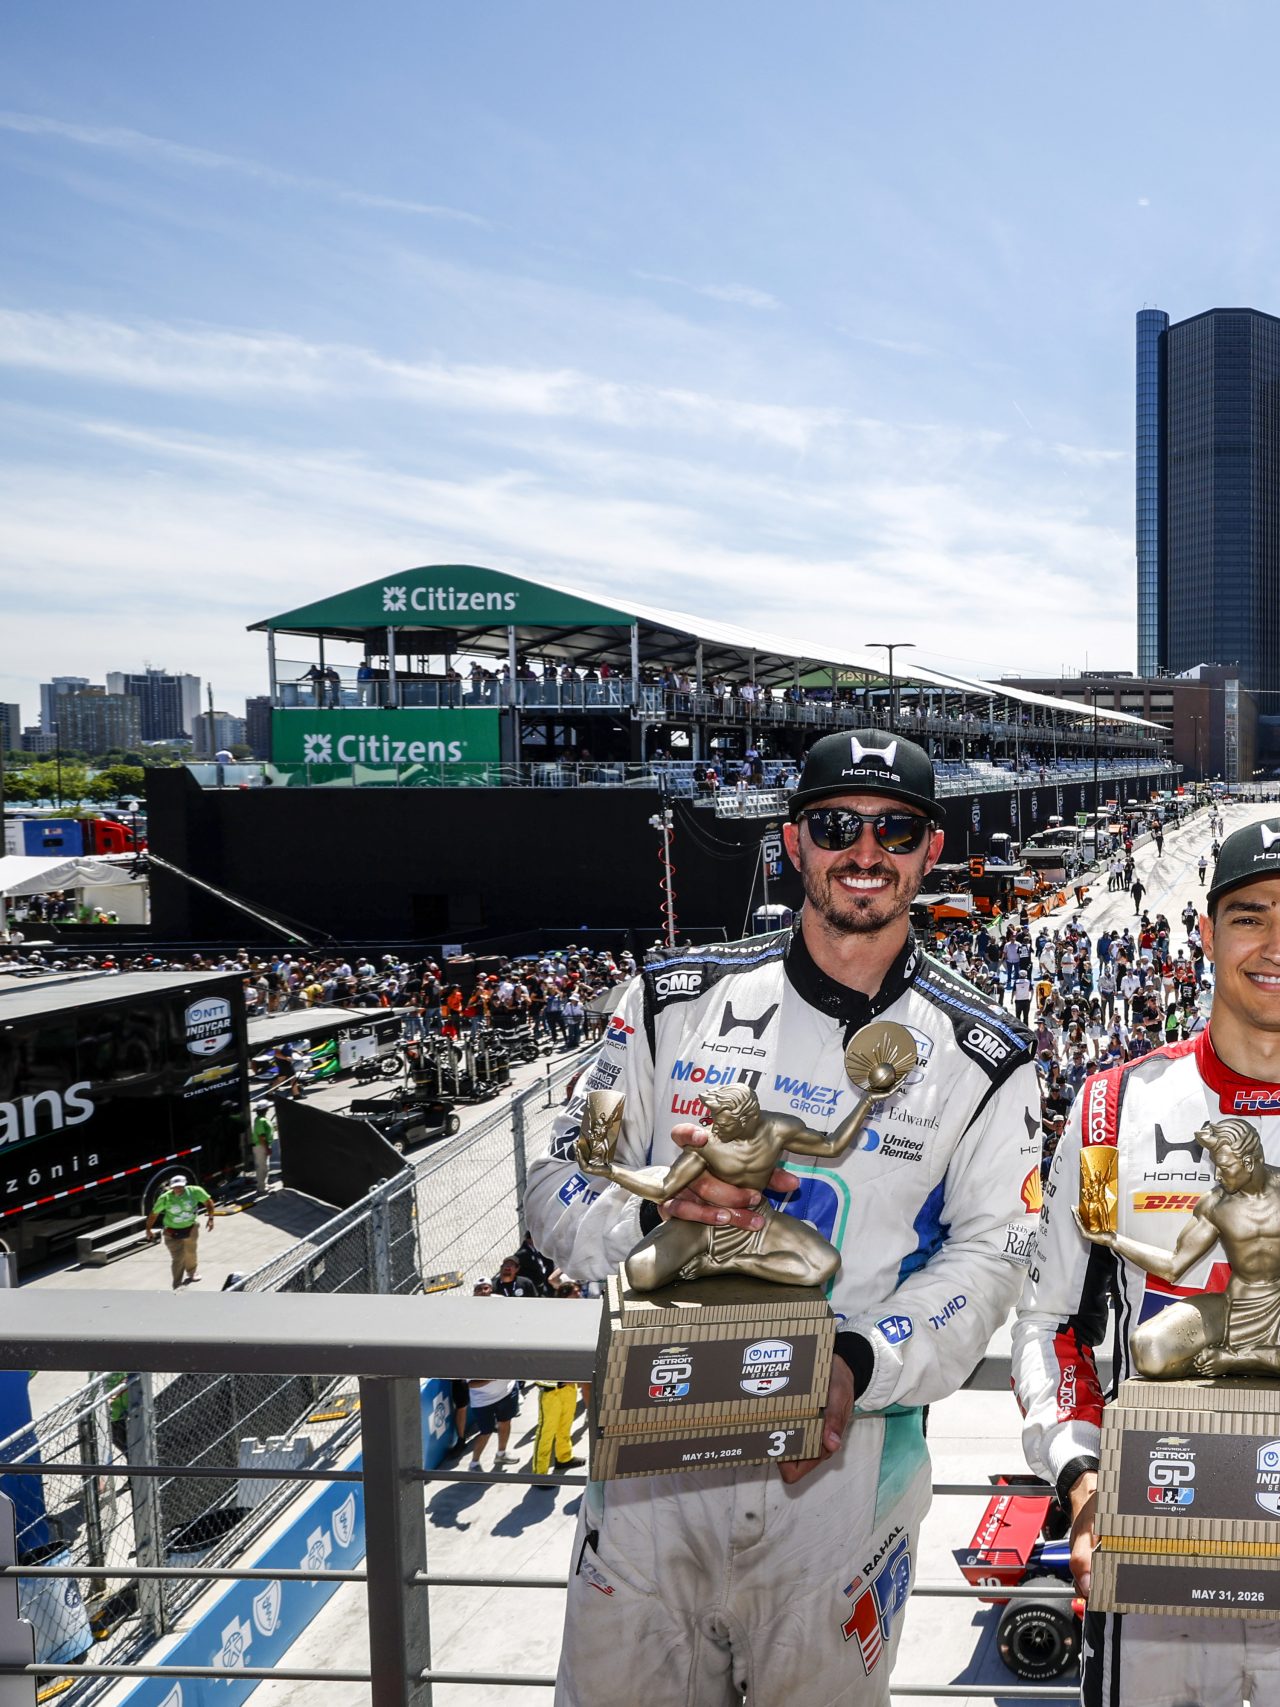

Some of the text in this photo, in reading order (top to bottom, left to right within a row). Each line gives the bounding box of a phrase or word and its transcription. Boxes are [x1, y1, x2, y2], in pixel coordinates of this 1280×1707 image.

[411, 586, 516, 611] Citizens
[337, 734, 462, 763] Citizens
[841, 768, 901, 783] Honda
[970, 858, 985, 878] 5
[655, 974, 702, 995] OMP
[203, 1004, 226, 1018] NTT
[186, 1018, 232, 1037] INDYCAR
[701, 1040, 767, 1058] Honda
[967, 1028, 1007, 1061] OMP
[671, 1059, 737, 1085] Mobil
[184, 1077, 241, 1098] CHEVROLET
[789, 1098, 836, 1117] GROUP
[1090, 1079, 1109, 1144] sparco
[887, 1106, 940, 1131] Edwards
[883, 1133, 924, 1151] United
[879, 1144, 923, 1162] Rentals
[1143, 1170, 1211, 1182] Honda
[652, 1356, 694, 1366] DETROIT
[763, 1349, 788, 1360] NTT
[650, 1363, 692, 1385] GP
[741, 1362, 791, 1375] INDYCAR
[750, 1371, 780, 1379] SERIES
[682, 1448, 742, 1462] MAY 31, 2026
[1150, 1451, 1196, 1460] DETROIT
[1148, 1459, 1196, 1486] GP
[862, 1524, 905, 1577] RAHAL
[841, 1533, 912, 1677] 15
[1191, 1589, 1265, 1602] MAY 31, 2026
[1015, 1610, 1056, 1622] Firestone
